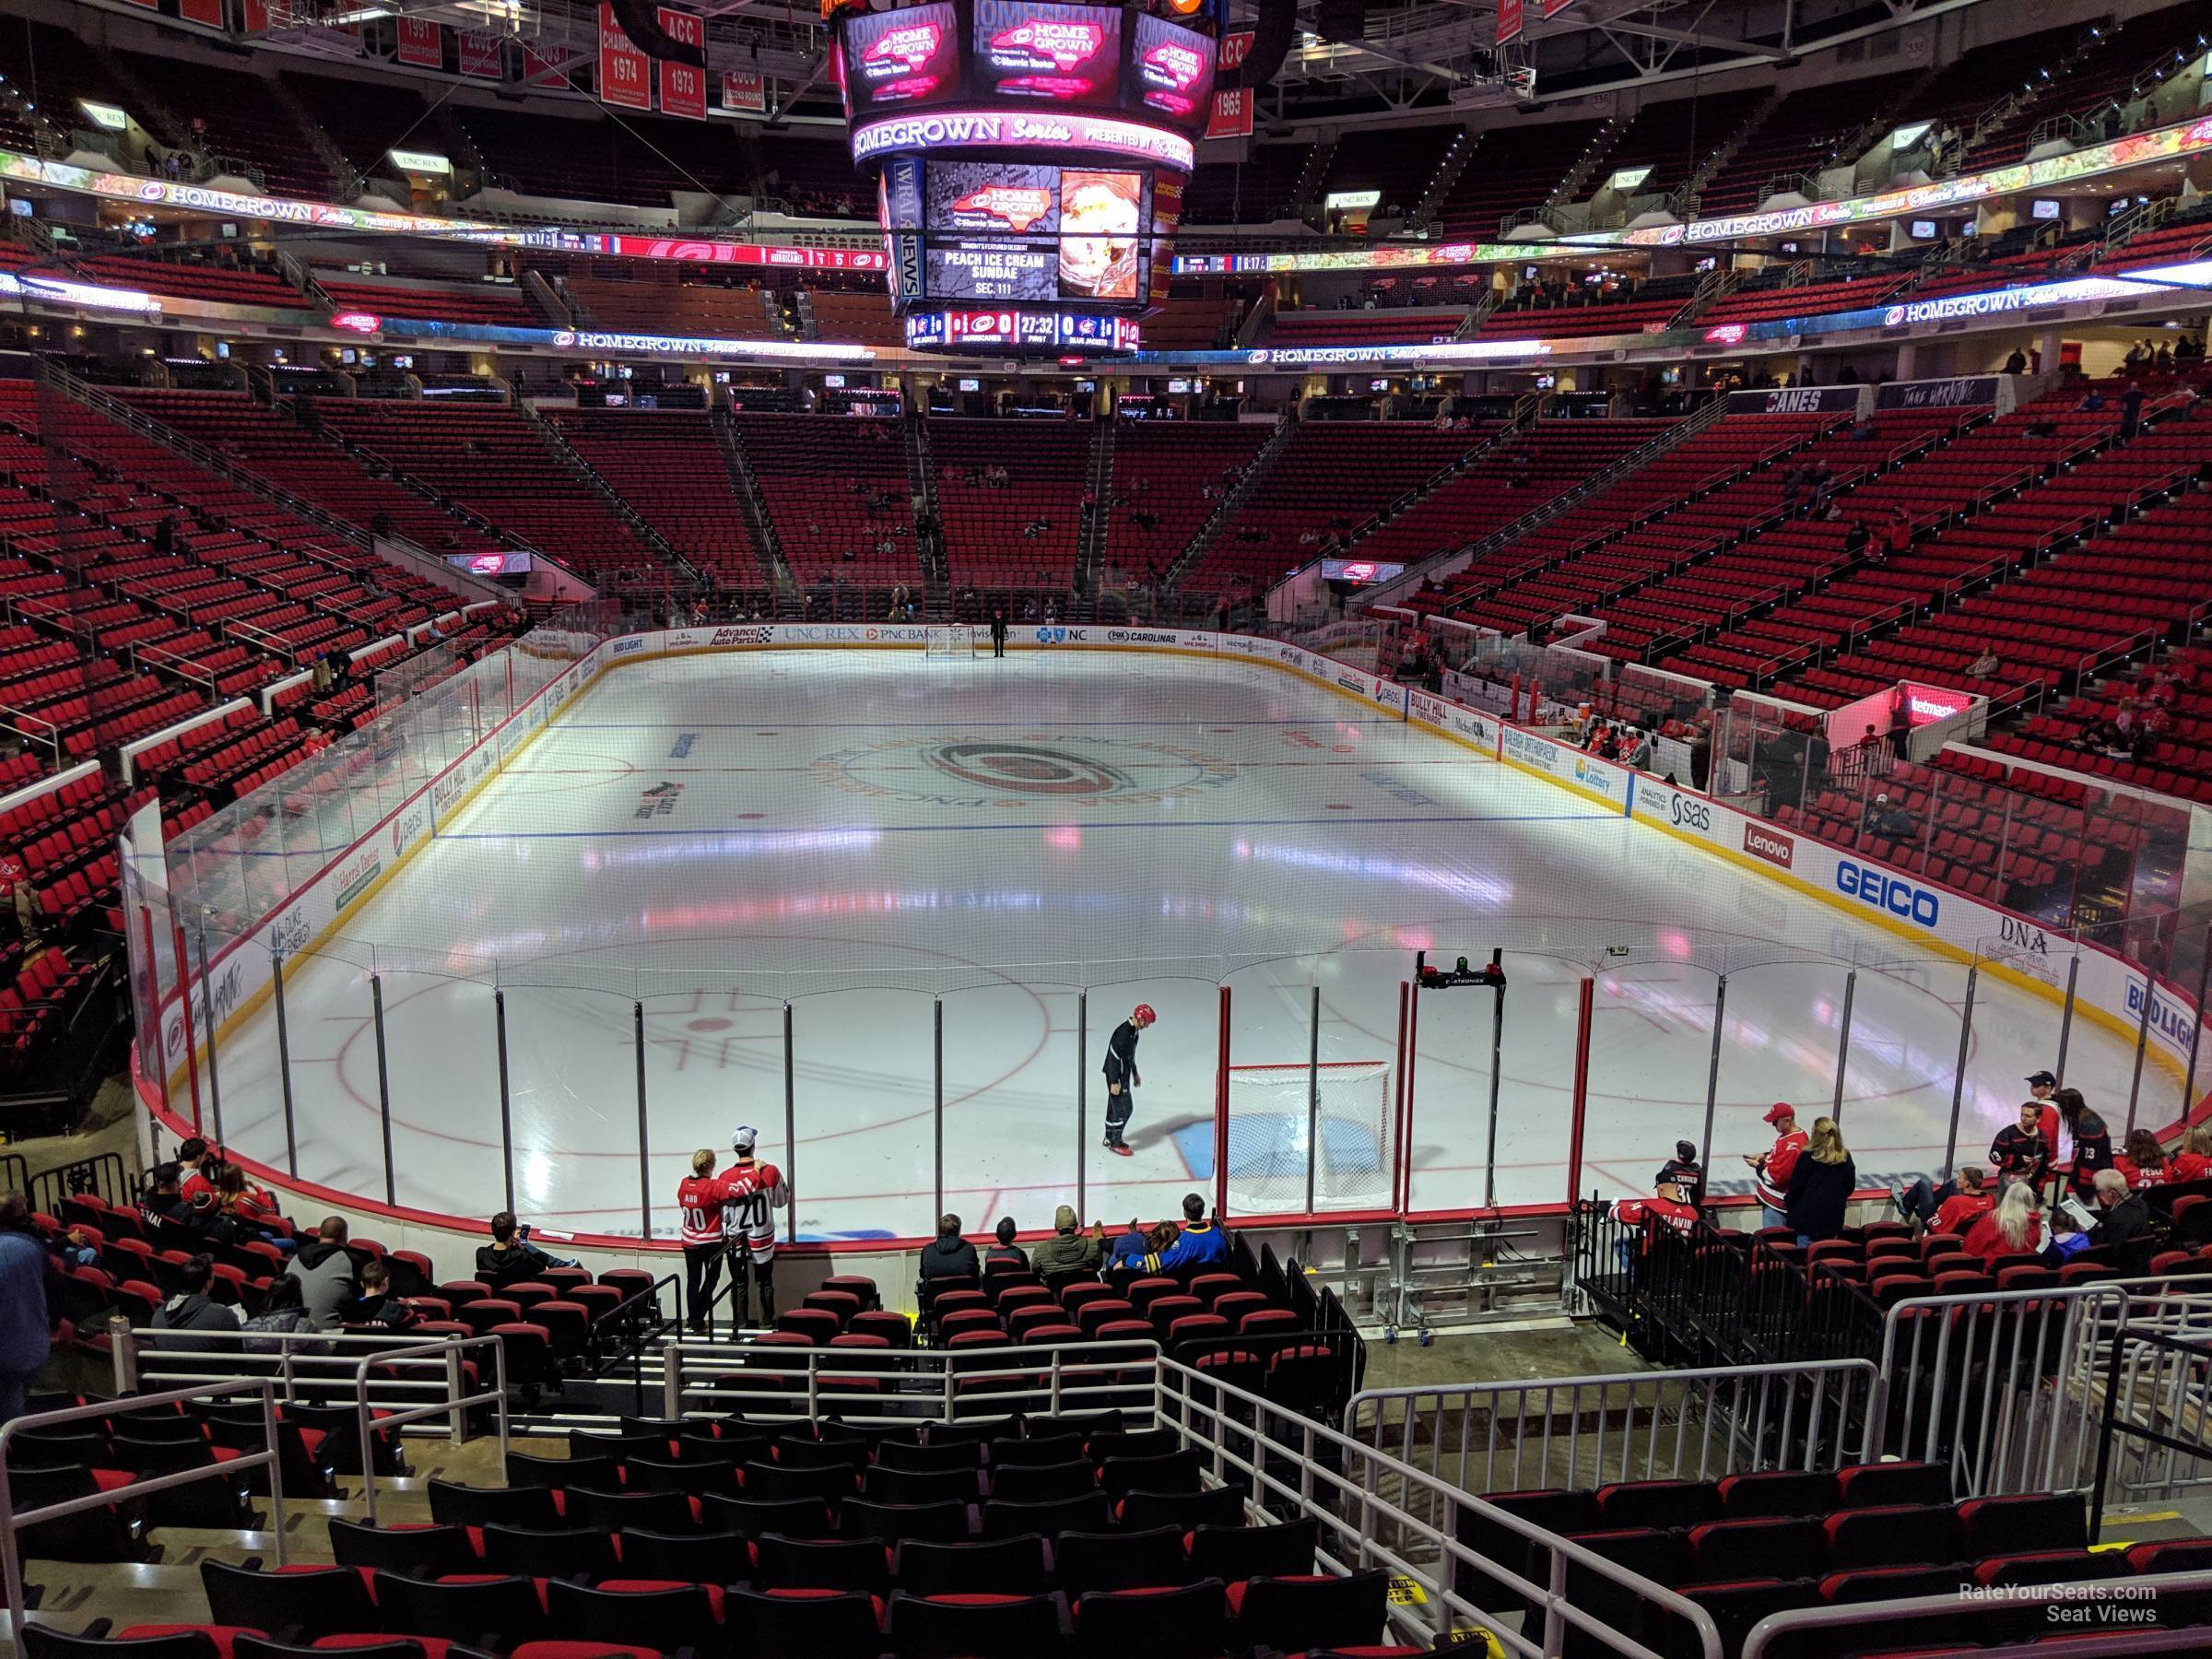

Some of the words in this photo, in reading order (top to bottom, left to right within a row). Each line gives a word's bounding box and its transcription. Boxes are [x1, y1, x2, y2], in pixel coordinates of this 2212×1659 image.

[669, 17, 694, 44] ACC
[890, 28, 932, 44] HOME
[1034, 24, 1090, 40] HOME
[892, 40, 935, 55] GROWN
[1034, 37, 1094, 51] GROWN
[1169, 46, 1198, 65] HOME
[613, 57, 638, 83] 1974
[1168, 59, 1198, 76] GROWN
[671, 69, 694, 95] 1973
[1218, 92, 1241, 116] 1965
[1013, 117, 1072, 141] Series
[1085, 127, 1139, 147] PRESENTED
[423, 159, 439, 168] REX
[1617, 175, 1634, 184] UNC
[896, 166, 915, 221] WRAL
[991, 190, 1041, 203] HOME
[1355, 194, 1371, 203] REX
[171, 187, 312, 221] HOMEGROWN
[319, 206, 354, 226] Series
[991, 202, 1044, 214] GROWN
[1688, 211, 1813, 241] HOMEGROWN
[1817, 205, 1853, 221] Series
[1862, 201, 1895, 213] PRESENTED
[1918, 189, 1952, 206] Harris
[1954, 182, 1991, 197] Teeter
[771, 253, 804, 264] HURRICANES
[875, 254, 883, 267] 0
[902, 231, 918, 294] NEWS
[945, 253, 982, 266] PEACH
[985, 253, 1004, 266] ICE
[1006, 255, 1044, 268] CREAM
[1243, 257, 1260, 270] 6:17
[971, 266, 1018, 279] SUNDAE
[976, 283, 995, 295] SEC.
[997, 284, 1011, 295] 111
[1906, 290, 2020, 323] HOMEGROWN
[999, 315, 1011, 334] 0
[1022, 317, 1053, 334] 27:32
[1063, 317, 1074, 335] 0
[579, 334, 702, 352] HOMEGROWN
[962, 334, 1002, 342] HURRICANES
[1070, 336, 1085, 345] BLUE
[1086, 337, 1108, 347] JACKETS
[1272, 349, 1386, 363] HOMEGROWN
[1766, 391, 1822, 413] CANES
[711, 637, 731, 646] Auto
[731, 635, 756, 645] Parts
[714, 628, 757, 638] Advance
[784, 628, 821, 641] UNC
[826, 628, 858, 641] REX
[1069, 629, 1086, 641] NC
[1112, 631, 1126, 640] FOX
[1131, 632, 1177, 643] CAROLINAS
[614, 642, 624, 653] BUD
[624, 640, 642, 650] LIGHT
[1382, 688, 1400, 705] pepsi
[1411, 693, 1431, 712] BULLY
[1432, 702, 1448, 719] HILL
[1417, 712, 1441, 725] VINEYARDS
[1456, 716, 1475, 734] Michael
[1484, 727, 1494, 742] Son
[1504, 729, 1524, 749] RALEIGH
[1524, 736, 1558, 762] ORTHOPAEDIC
[1585, 770, 1611, 793] Lottery
[435, 778, 453, 806] BULLY
[1641, 787, 1667, 804] ANALYTICS
[1640, 796, 1661, 809] POWERED
[1683, 800, 1711, 830] sas
[1747, 830, 1790, 860] Lenovo
[339, 865, 360, 891] Harris
[1837, 860, 1939, 928] GEICO
[285, 906, 301, 935] DUKE
[288, 923, 310, 956] ENERGY
[1999, 915, 2048, 955] DNA
[2128, 984, 2159, 1024] BUD
[2161, 1006, 2194, 1053] LIGH
[2140, 1167, 2165, 1177] PESCE
[685, 1194, 698, 1203] AHO
[1677, 1183, 1692, 1204] 37
[683, 1206, 707, 1231] 20
[739, 1193, 767, 1230] 20
[1663, 1215, 1693, 1230] SLAVIN
[1389, 1579, 1416, 1587] TION
[1452, 1630, 1490, 1642] UTION
